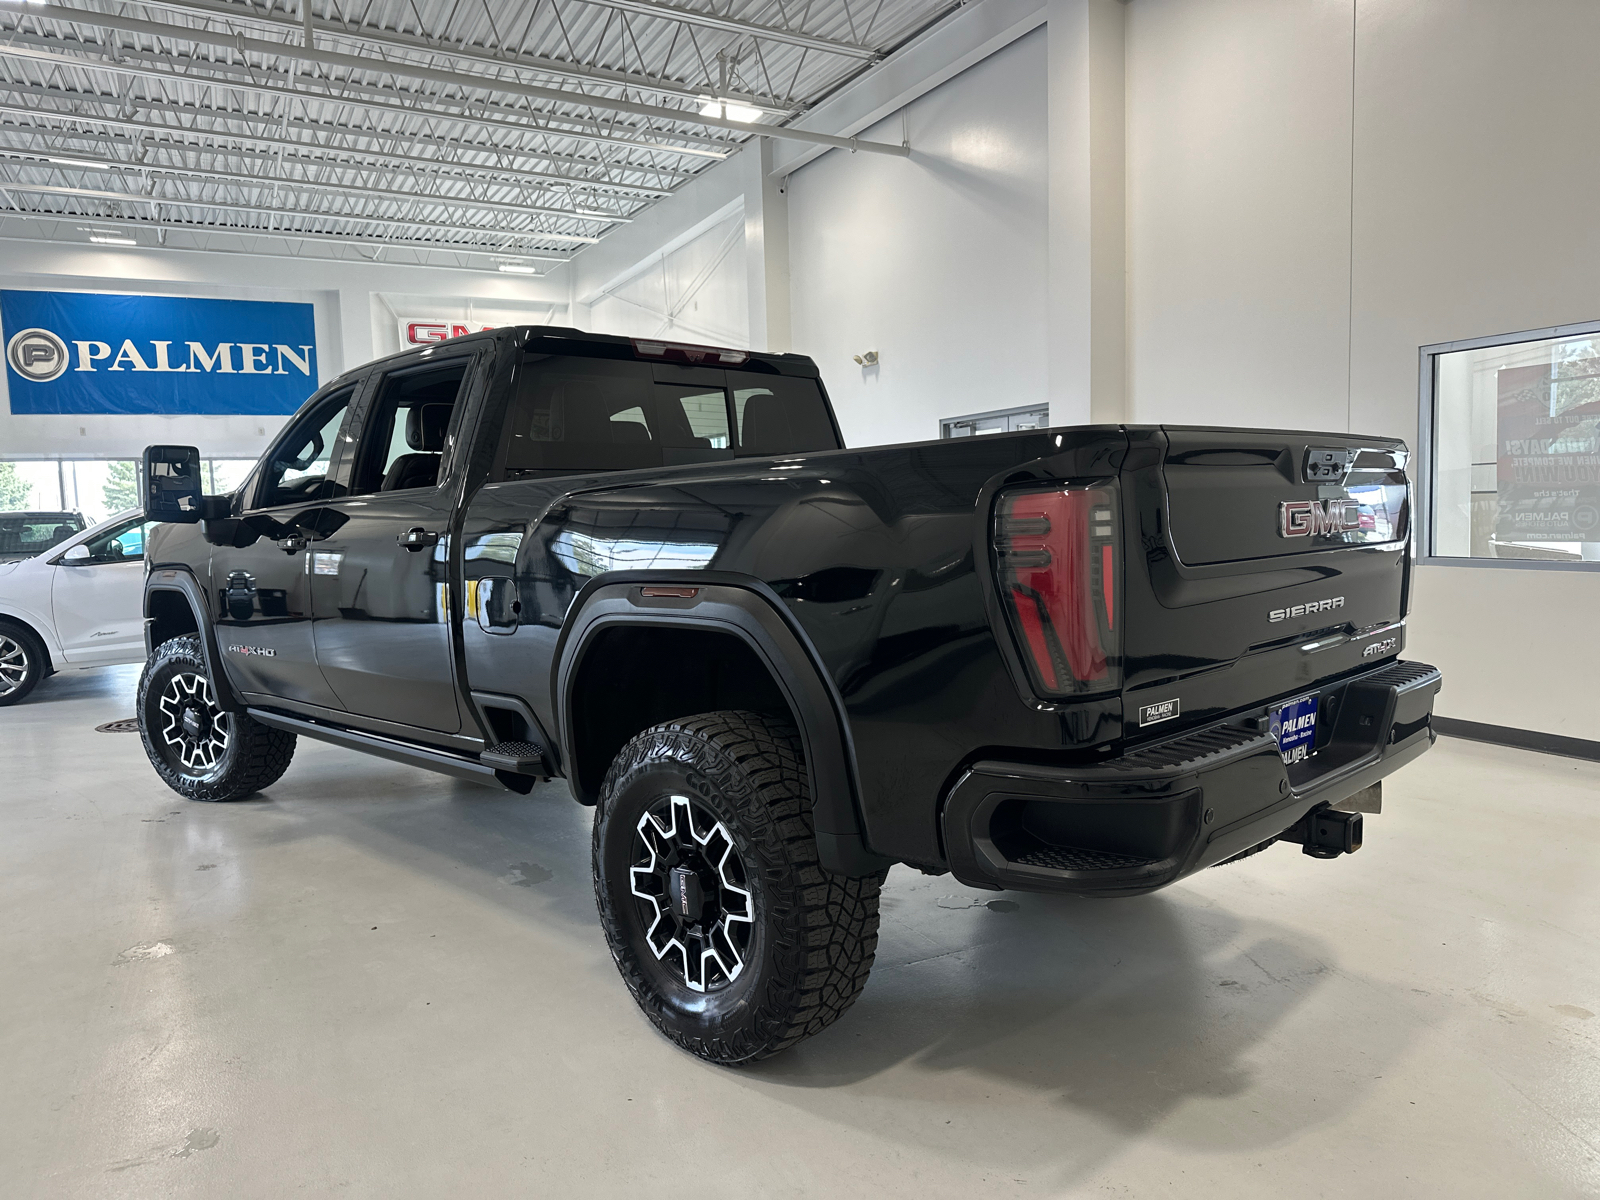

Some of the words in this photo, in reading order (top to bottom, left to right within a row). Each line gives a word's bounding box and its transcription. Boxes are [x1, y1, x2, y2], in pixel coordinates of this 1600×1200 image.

[71, 338, 314, 376] PALMEN
[1278, 500, 1360, 538] GMC
[1267, 596, 1345, 623] SIERRA
[1362, 637, 1397, 658] AT4X
[1146, 702, 1174, 717] PALMEN
[1281, 711, 1317, 735] PALMEN
